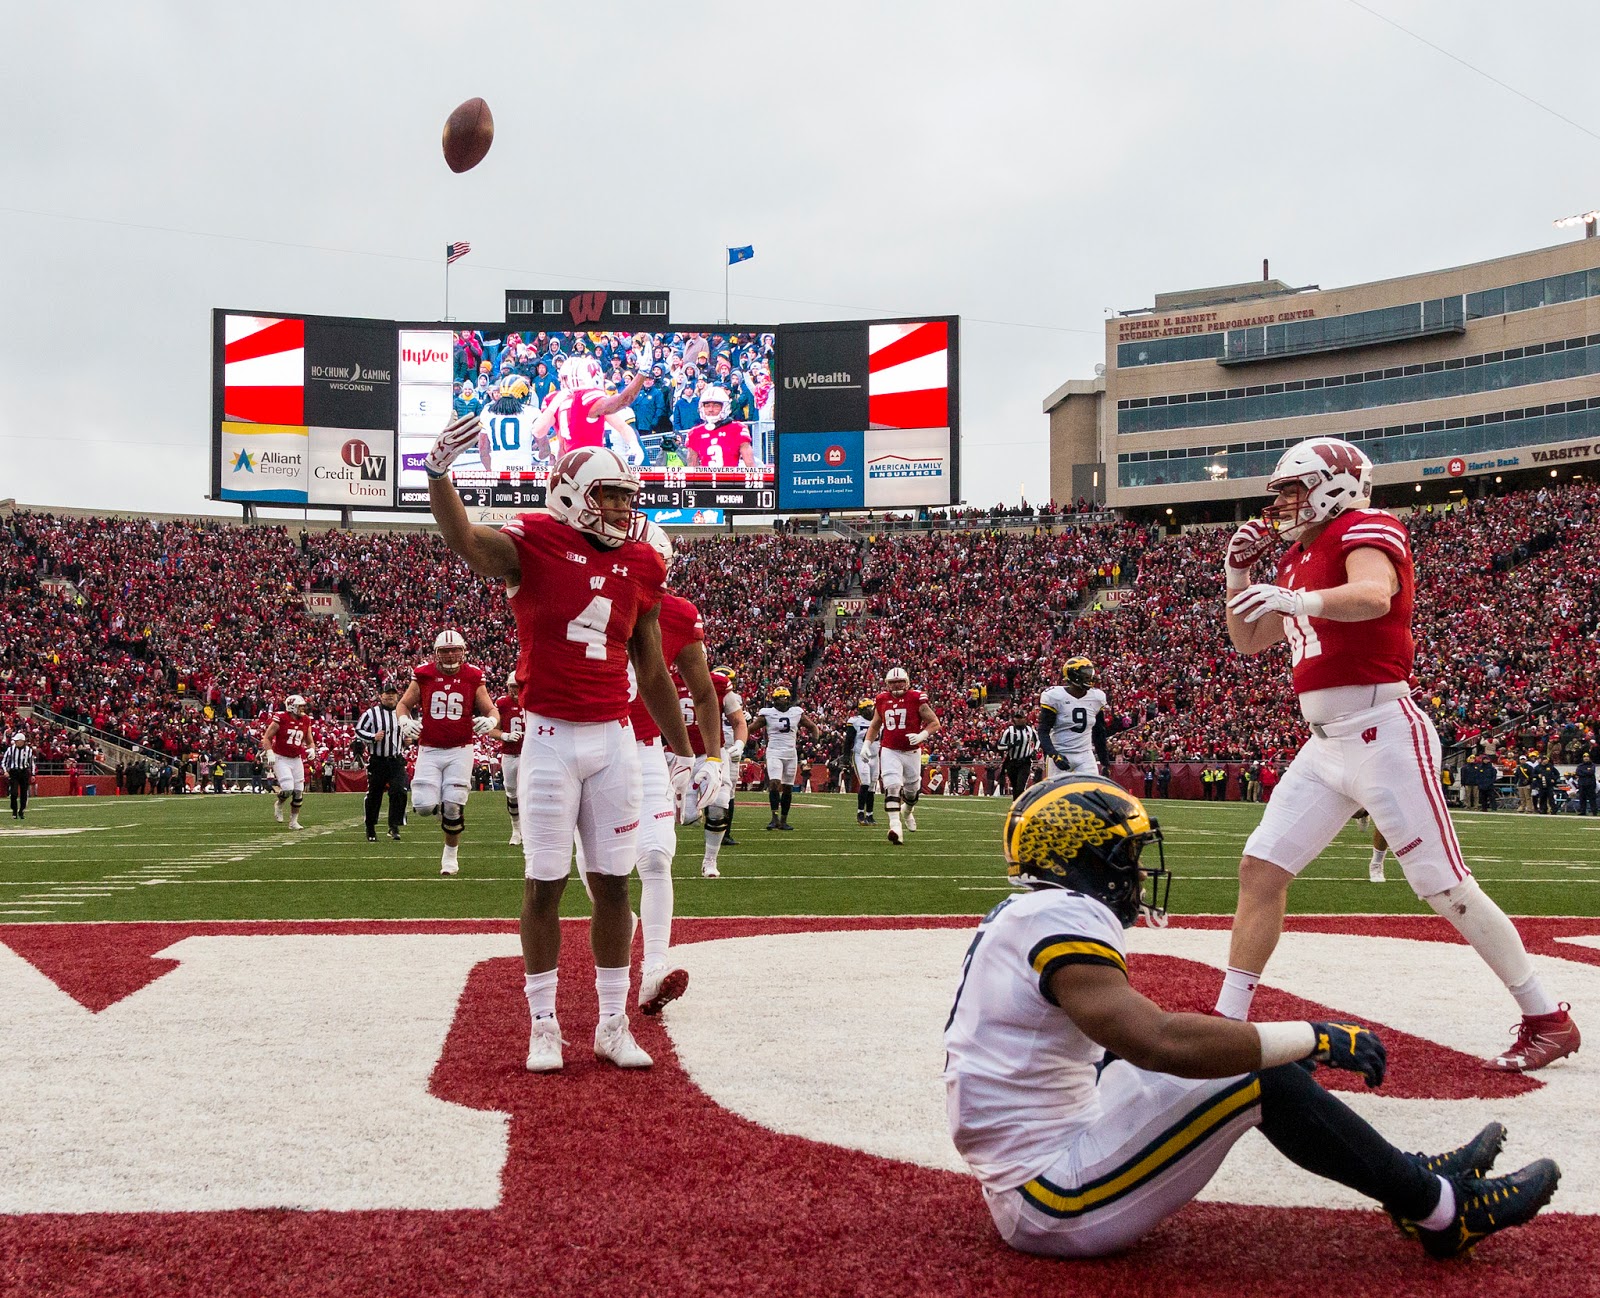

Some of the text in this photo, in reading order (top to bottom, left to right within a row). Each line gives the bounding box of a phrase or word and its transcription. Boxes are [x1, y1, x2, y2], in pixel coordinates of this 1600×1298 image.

[569, 292, 607, 325] W
[1119, 319, 1160, 332] STEPHEN
[1175, 312, 1218, 325] BENNETT
[1119, 308, 1315, 342] STUDENT-ATHLETE PERFORMANCE CENTER
[311, 365, 391, 381] HO-CHUNK GAMING
[329, 383, 373, 392] WISCONSIN
[489, 417, 521, 451] 10
[260, 452, 302, 465] Alliant
[349, 443, 386, 480] UW
[793, 453, 821, 463] BMO
[1531, 446, 1591, 462] VARSITY
[260, 464, 300, 477] Energy
[1311, 443, 1364, 483] W
[1468, 457, 1519, 471] Harris Bank
[314, 464, 354, 481] Credit
[454, 471, 500, 479] WISCONSIN
[874, 470, 937, 478] INSURANCE
[1423, 467, 1445, 476] BMO
[456, 479, 499, 487] MICHIGAN
[793, 475, 853, 486] Harris Bank
[349, 483, 387, 497] Union
[478, 494, 486, 506] 2
[495, 494, 512, 502] DOWN
[514, 492, 521, 504] 3
[523, 494, 530, 502] TO
[531, 494, 539, 502] GO
[638, 492, 655, 505] 24
[672, 493, 680, 505] 3
[688, 496, 696, 508] 3
[756, 492, 773, 508] 10
[1234, 535, 1274, 563] WISCNSIN
[589, 576, 606, 590] W
[566, 595, 613, 660] 4
[430, 690, 464, 721] 66
[778, 717, 791, 733] 3
[884, 708, 907, 731] 67
[1070, 707, 1088, 734] 9
[286, 729, 304, 747] 79
